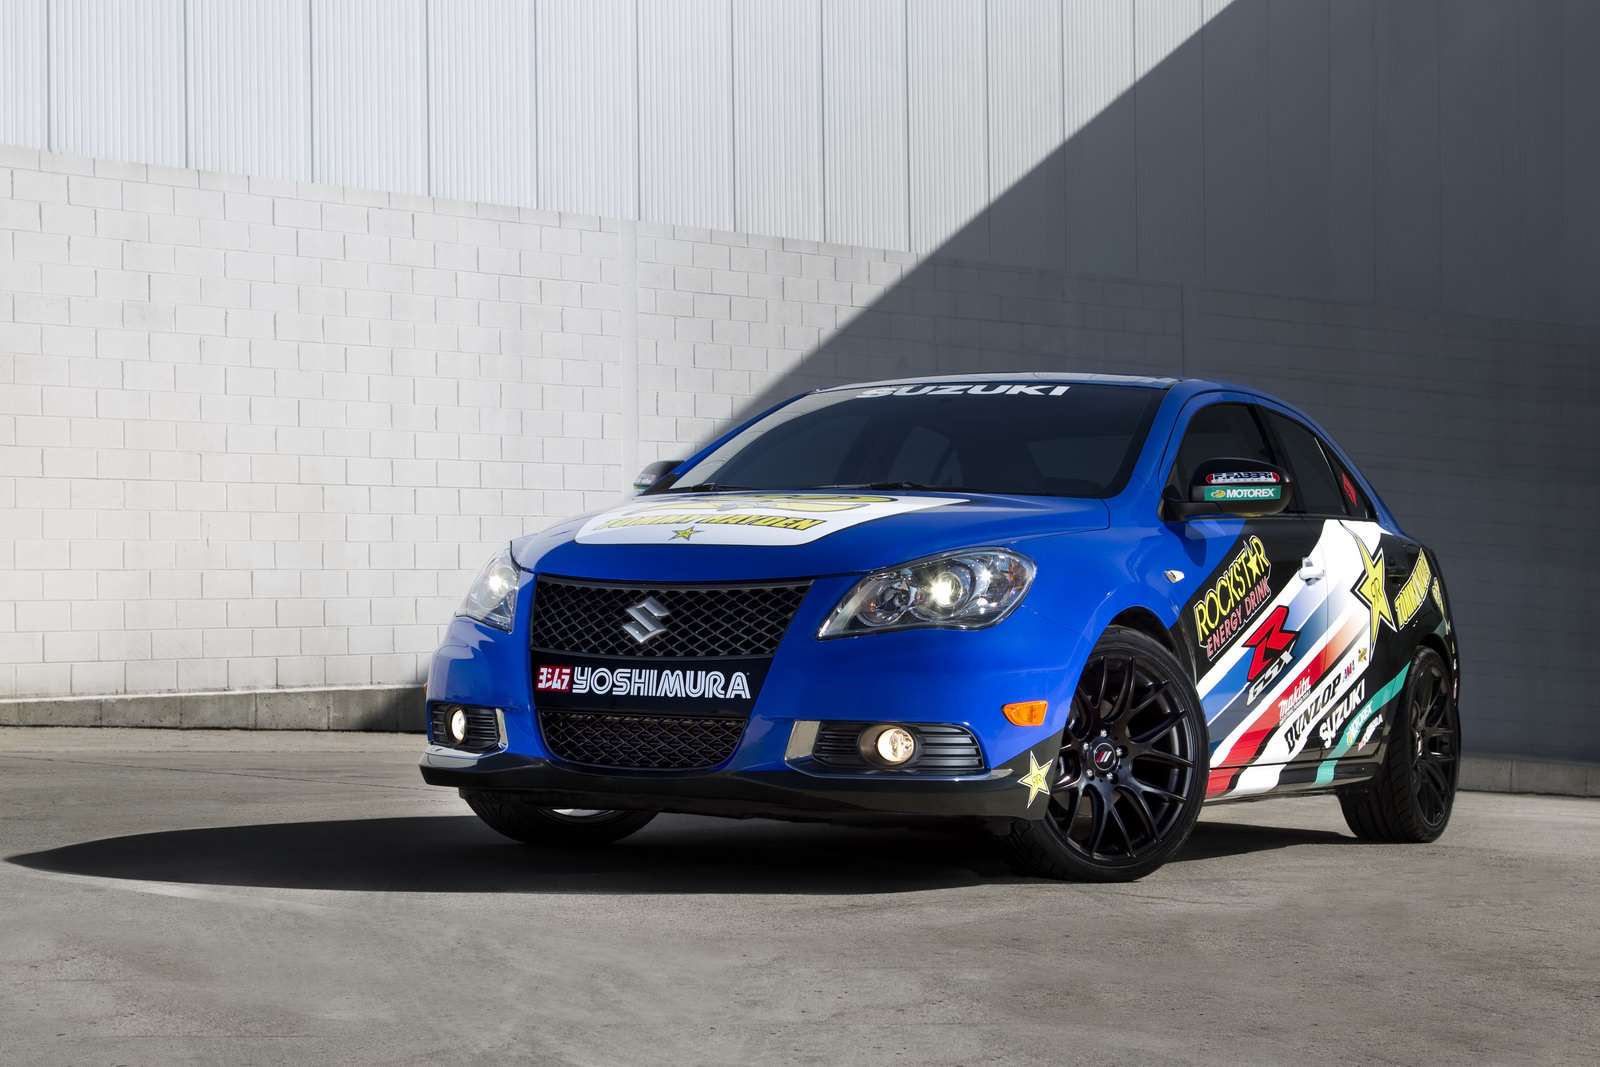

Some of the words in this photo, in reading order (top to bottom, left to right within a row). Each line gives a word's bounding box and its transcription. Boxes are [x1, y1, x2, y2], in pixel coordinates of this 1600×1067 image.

[855, 384, 1070, 399] SUZUKI
[1226, 488, 1275, 498] MOTOREX
[696, 514, 827, 531] HAYDEN
[1207, 604, 1243, 657] ENERGY
[1245, 575, 1271, 616] DRINK
[572, 666, 751, 699] YOSHIMURA
[1284, 672, 1342, 755] DUNLOP
[1319, 678, 1367, 749] SUZUKI
